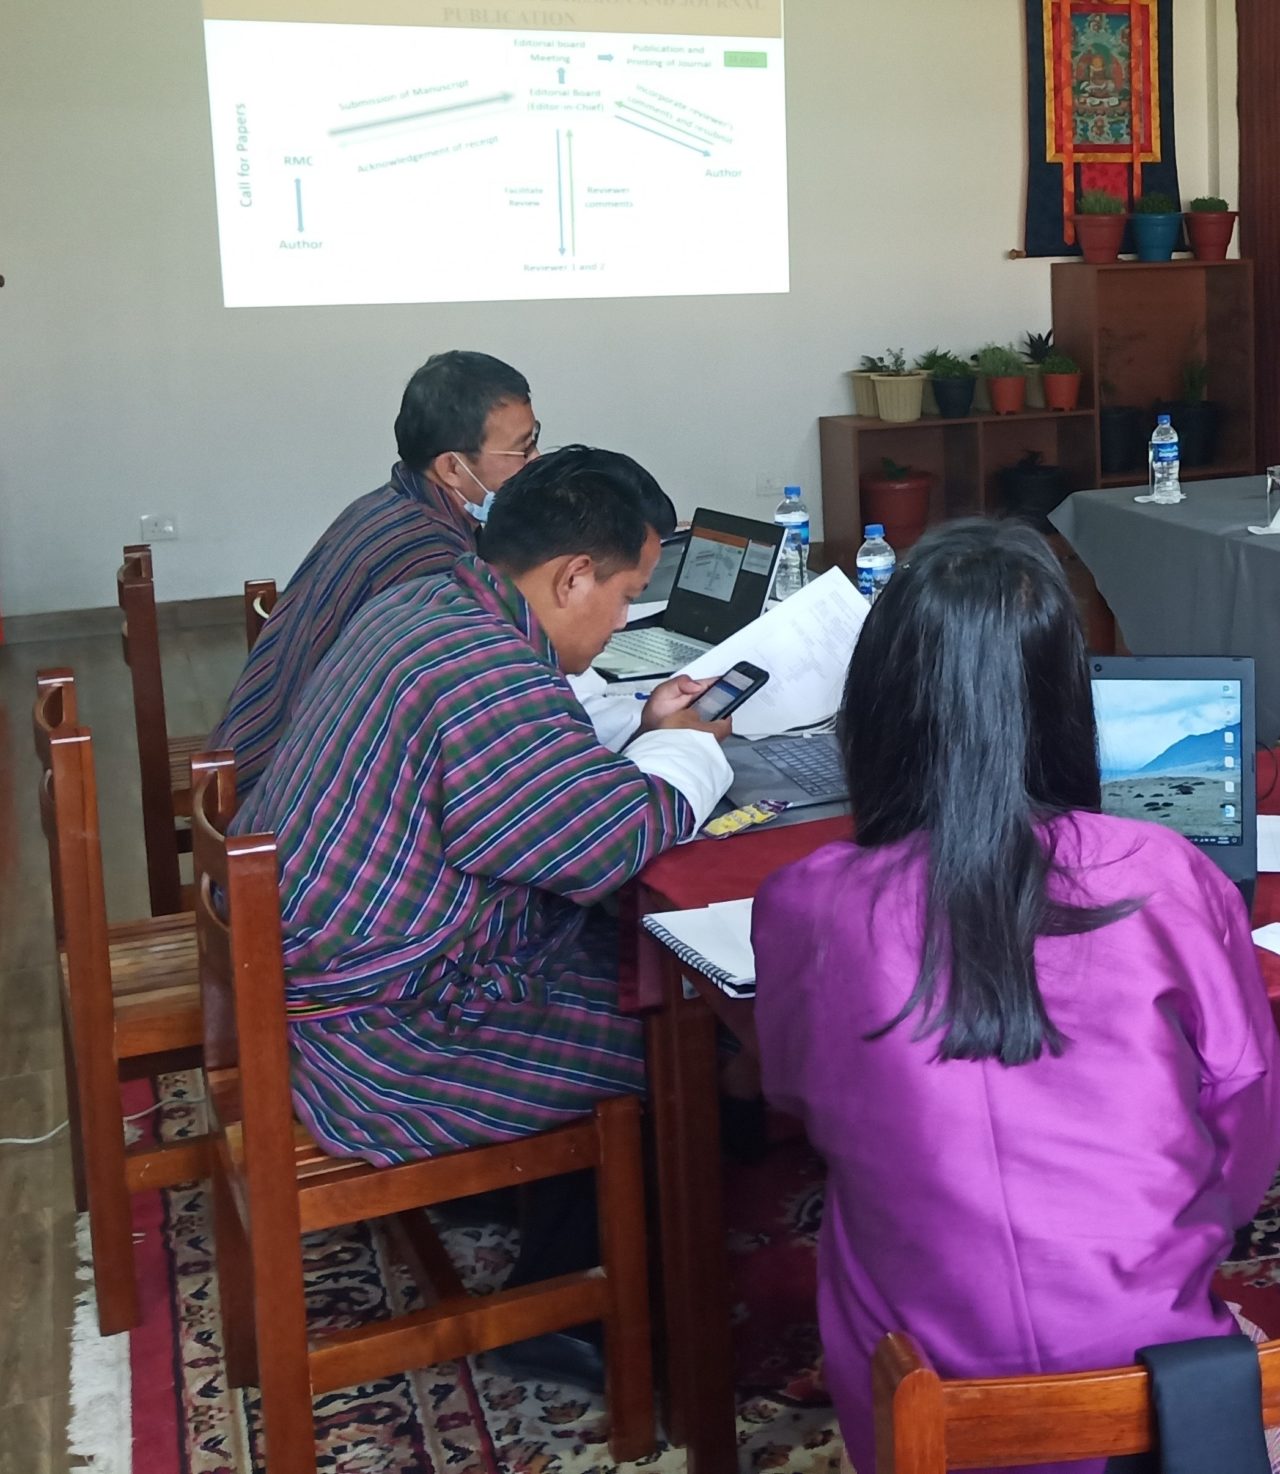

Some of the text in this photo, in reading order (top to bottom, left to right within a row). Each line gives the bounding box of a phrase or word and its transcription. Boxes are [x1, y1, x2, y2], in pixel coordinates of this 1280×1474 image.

[443, 7, 577, 26] PUBLICATION
[530, 53, 570, 64] Meeting
[338, 93, 397, 111] Submission
[412, 79, 470, 96] Manuscript
[572, 88, 602, 98] Board
[235, 103, 252, 208] Call for Papers
[283, 155, 314, 167] RMC
[705, 168, 743, 178] Author
[278, 239, 323, 250] Author
